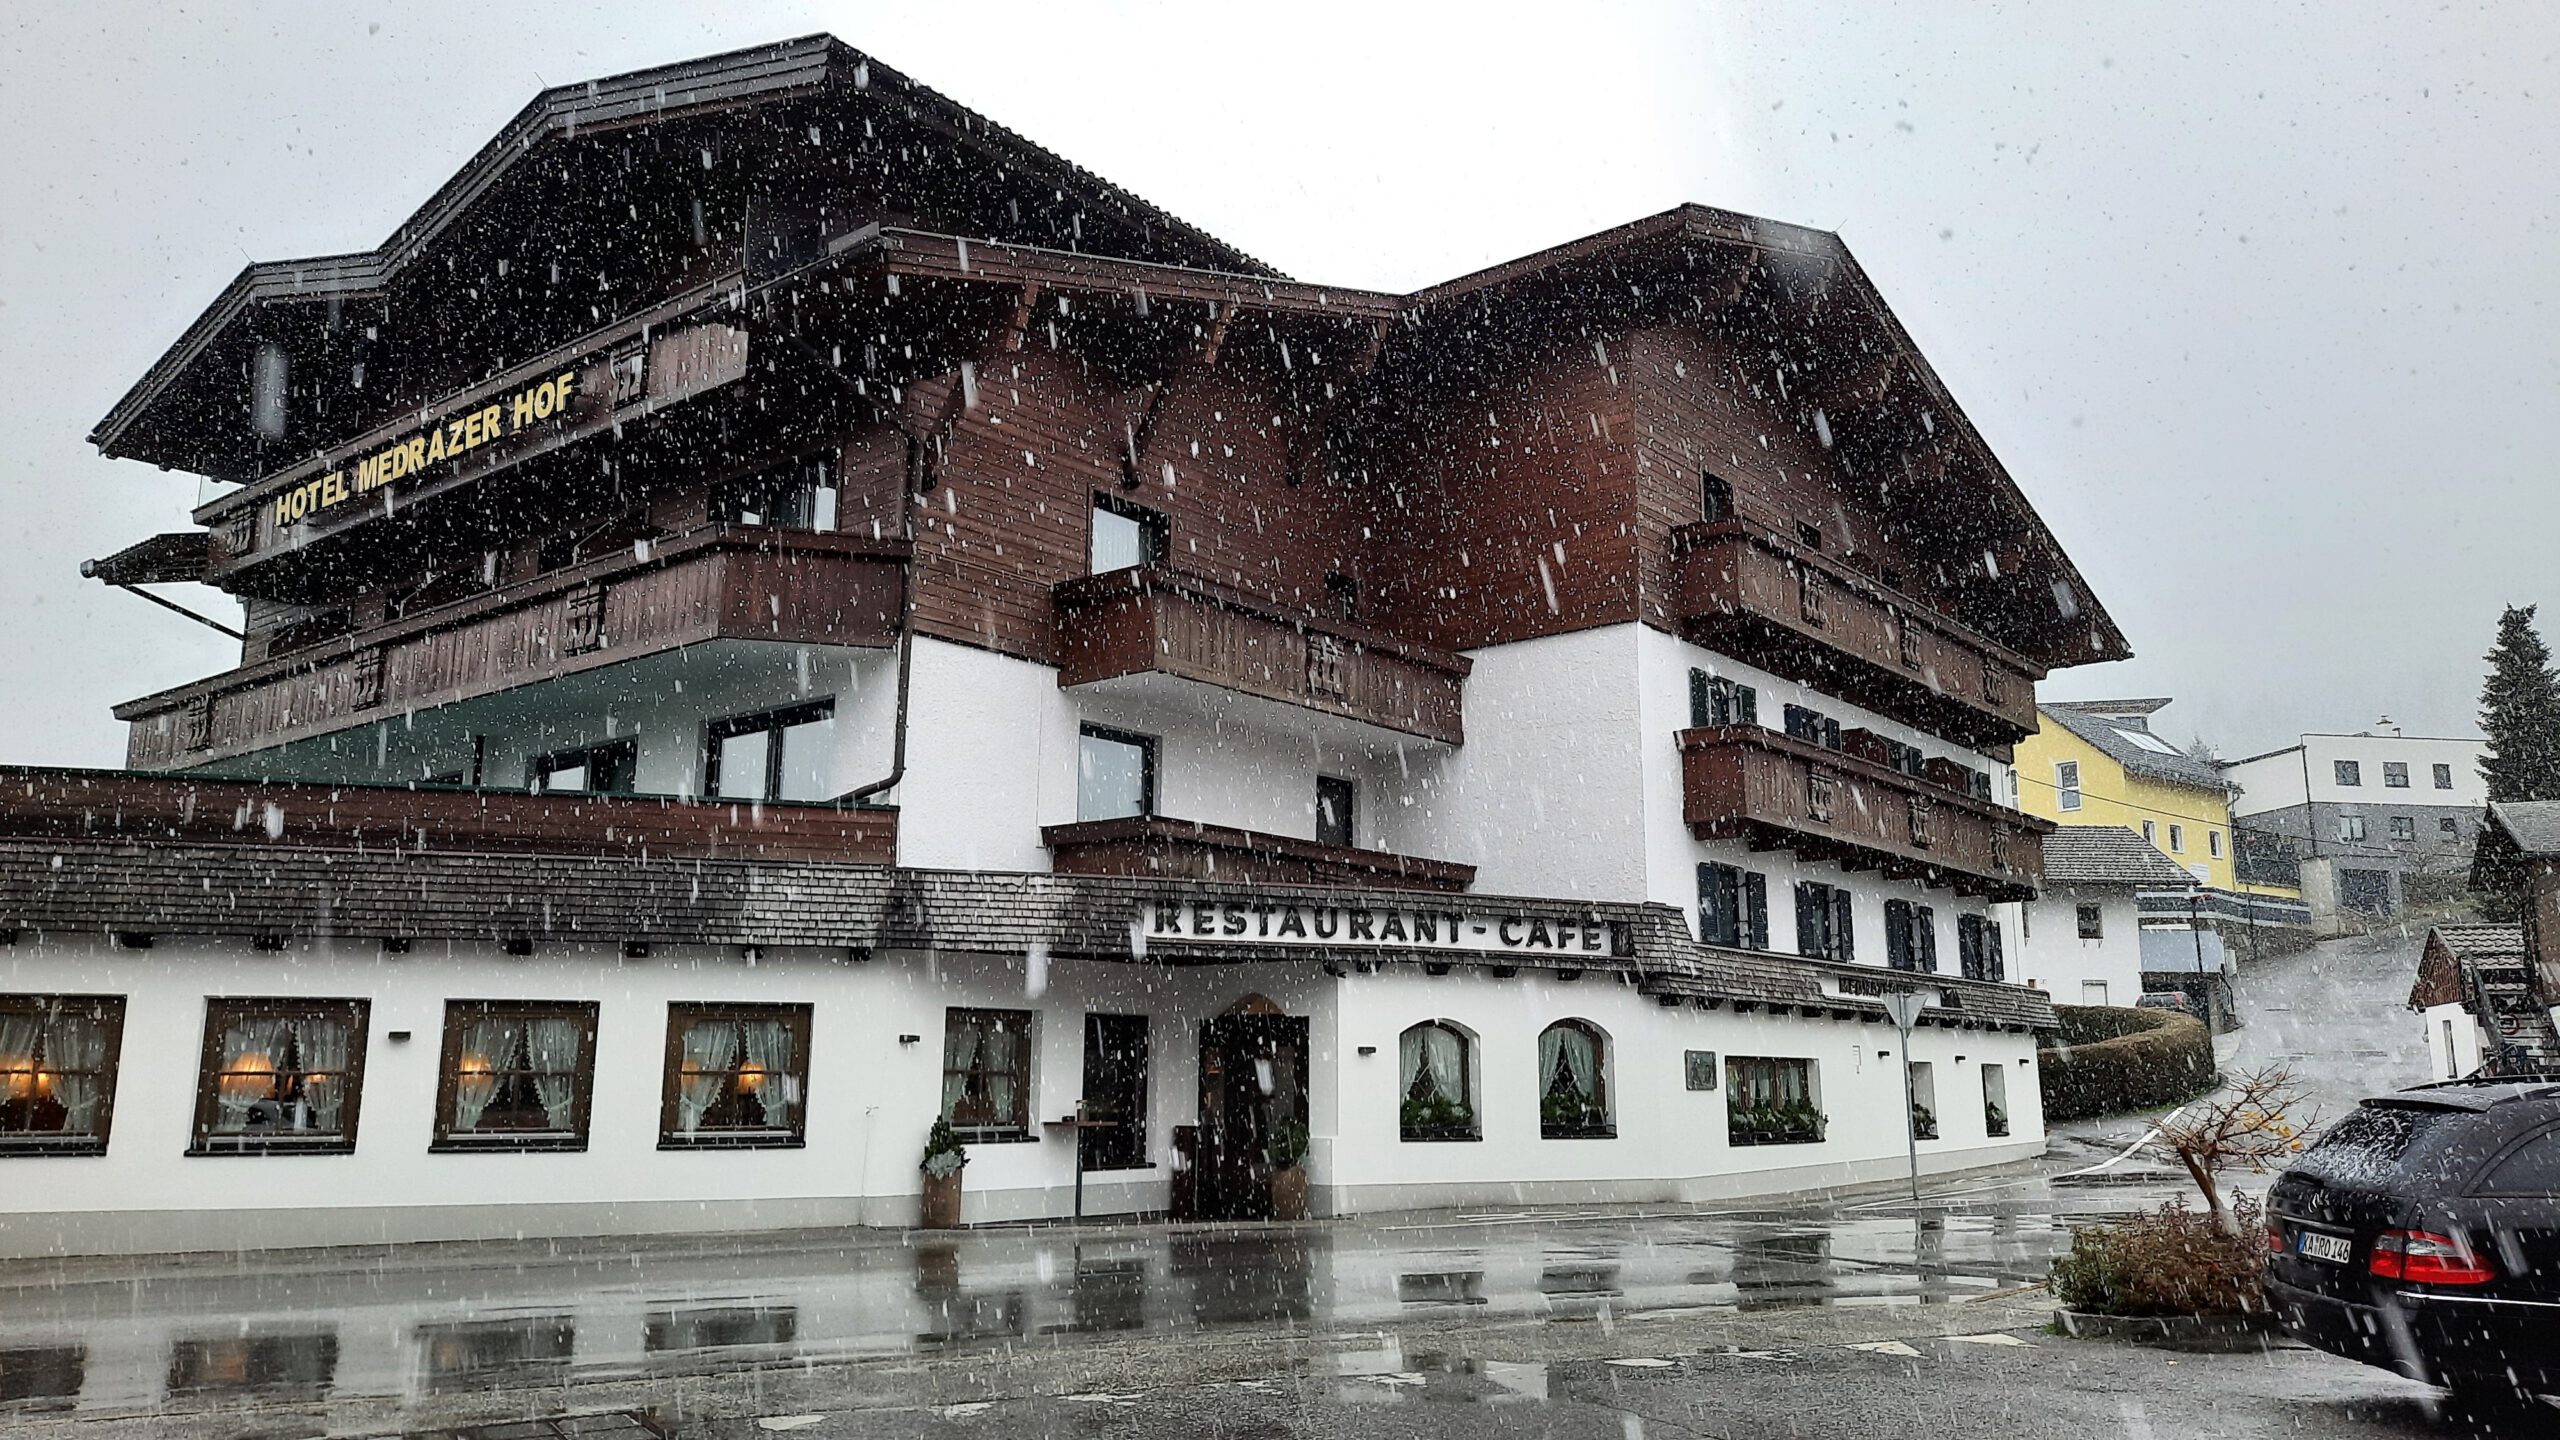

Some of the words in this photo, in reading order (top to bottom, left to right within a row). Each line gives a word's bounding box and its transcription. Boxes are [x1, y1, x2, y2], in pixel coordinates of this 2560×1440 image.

[275, 470, 349, 526] HOTEL
[357, 404, 502, 494] MEDRAZER
[512, 371, 575, 429] HOF
[2304, 1234, 2314, 1253] KA
[2331, 1240, 2349, 1261] 146
